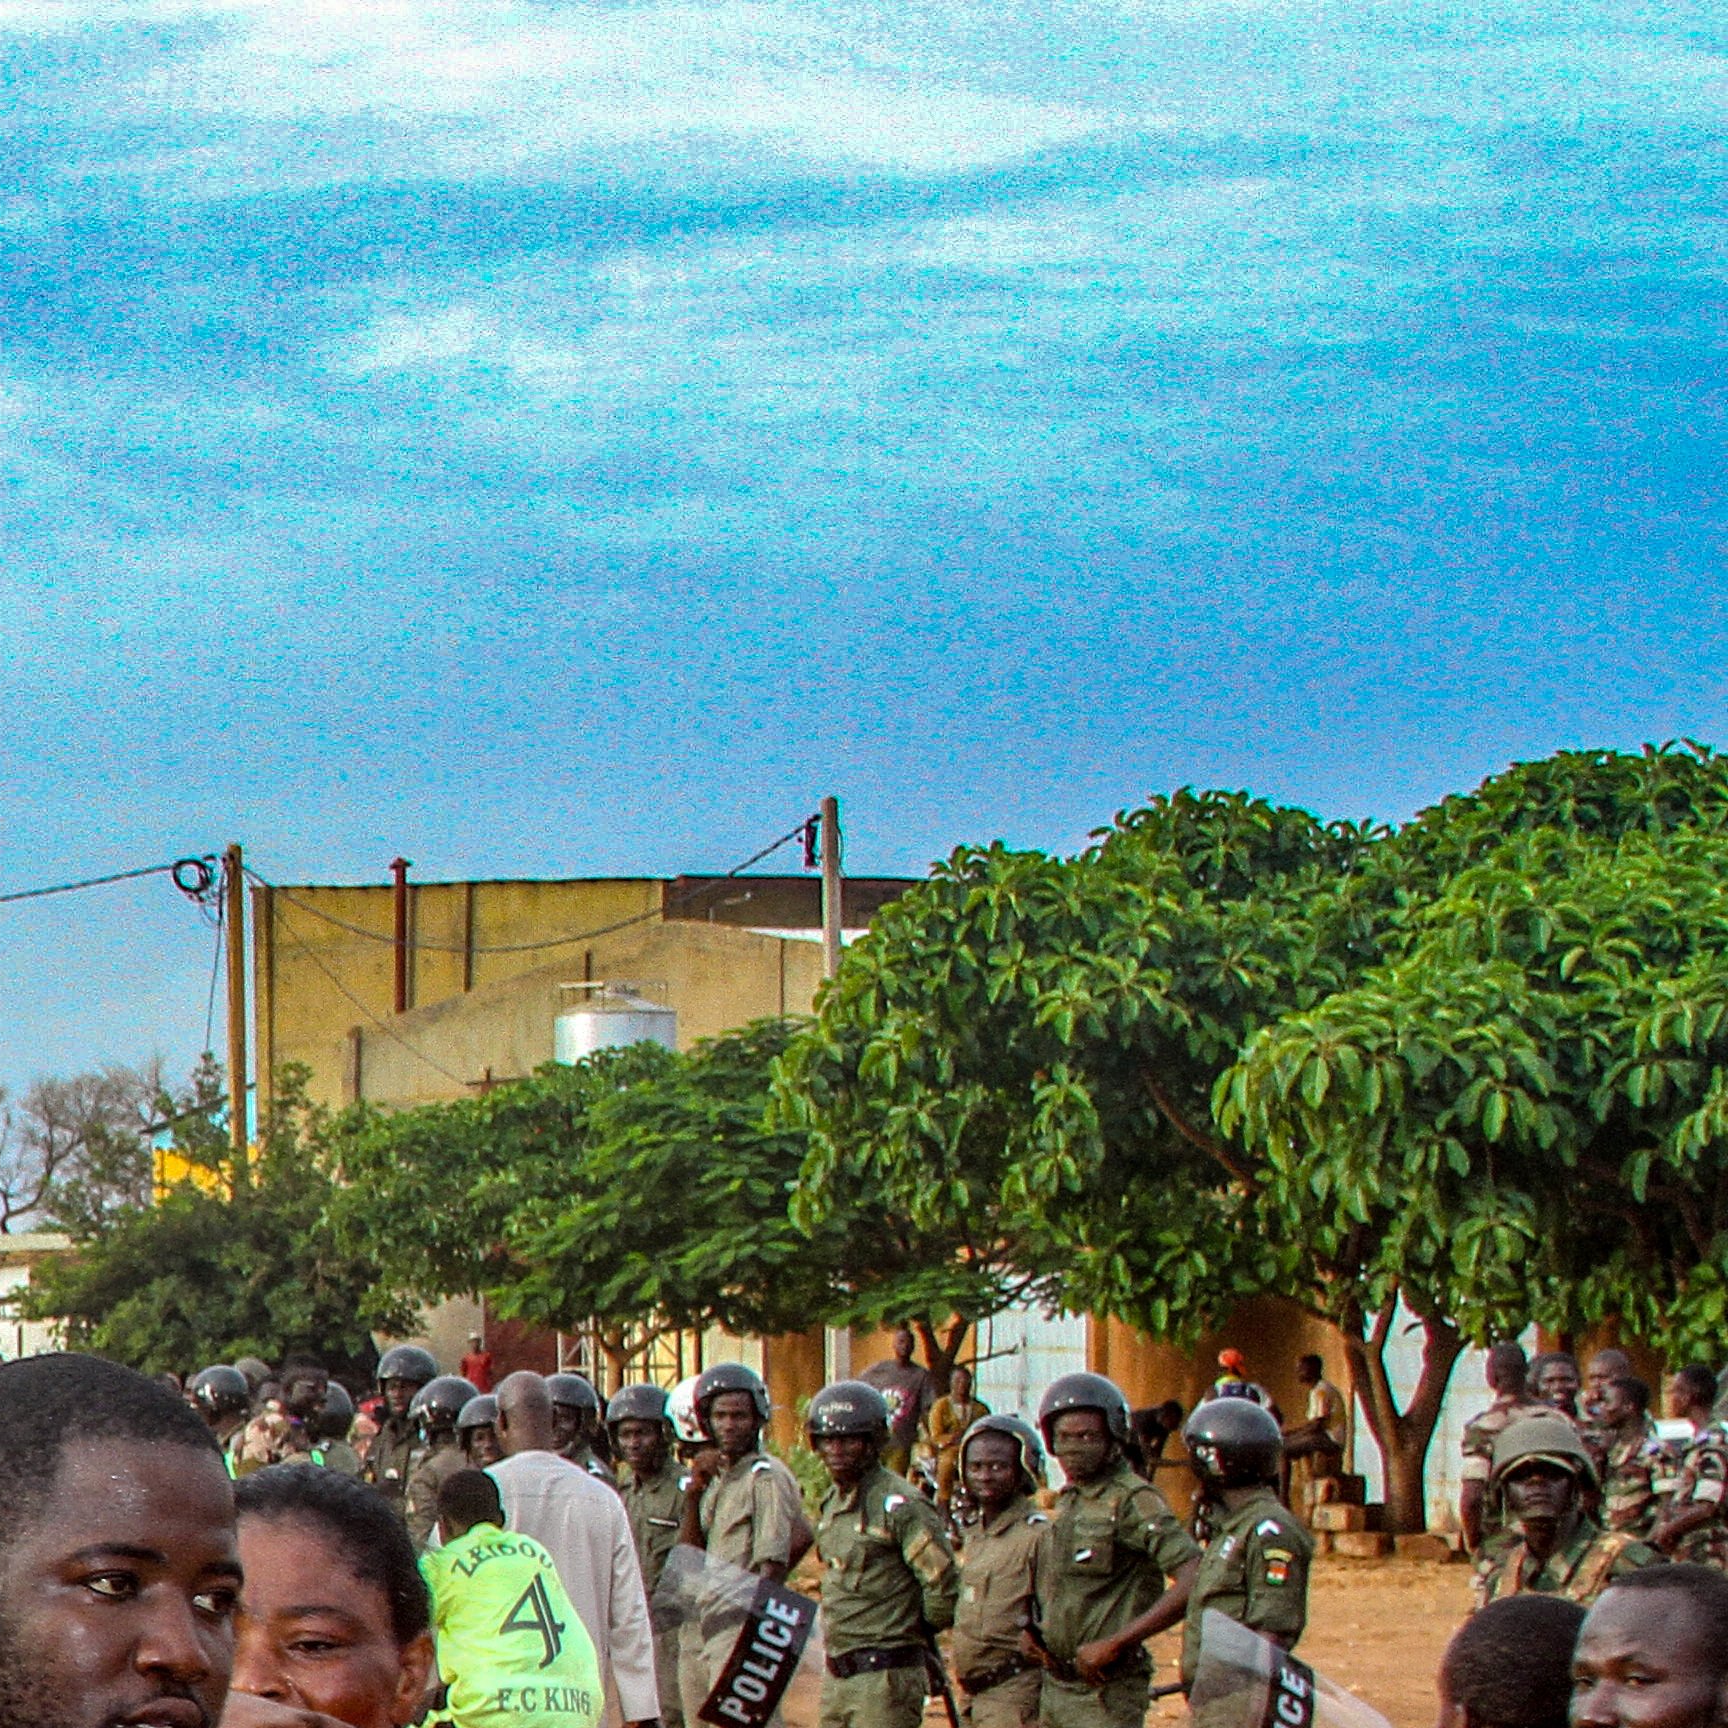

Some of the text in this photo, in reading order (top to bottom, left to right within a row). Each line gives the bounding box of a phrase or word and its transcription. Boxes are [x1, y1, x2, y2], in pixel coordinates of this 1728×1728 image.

[499, 1571, 565, 1670] 4
[718, 1597, 800, 1725] POLICE
[545, 1686, 591, 1715] KING
